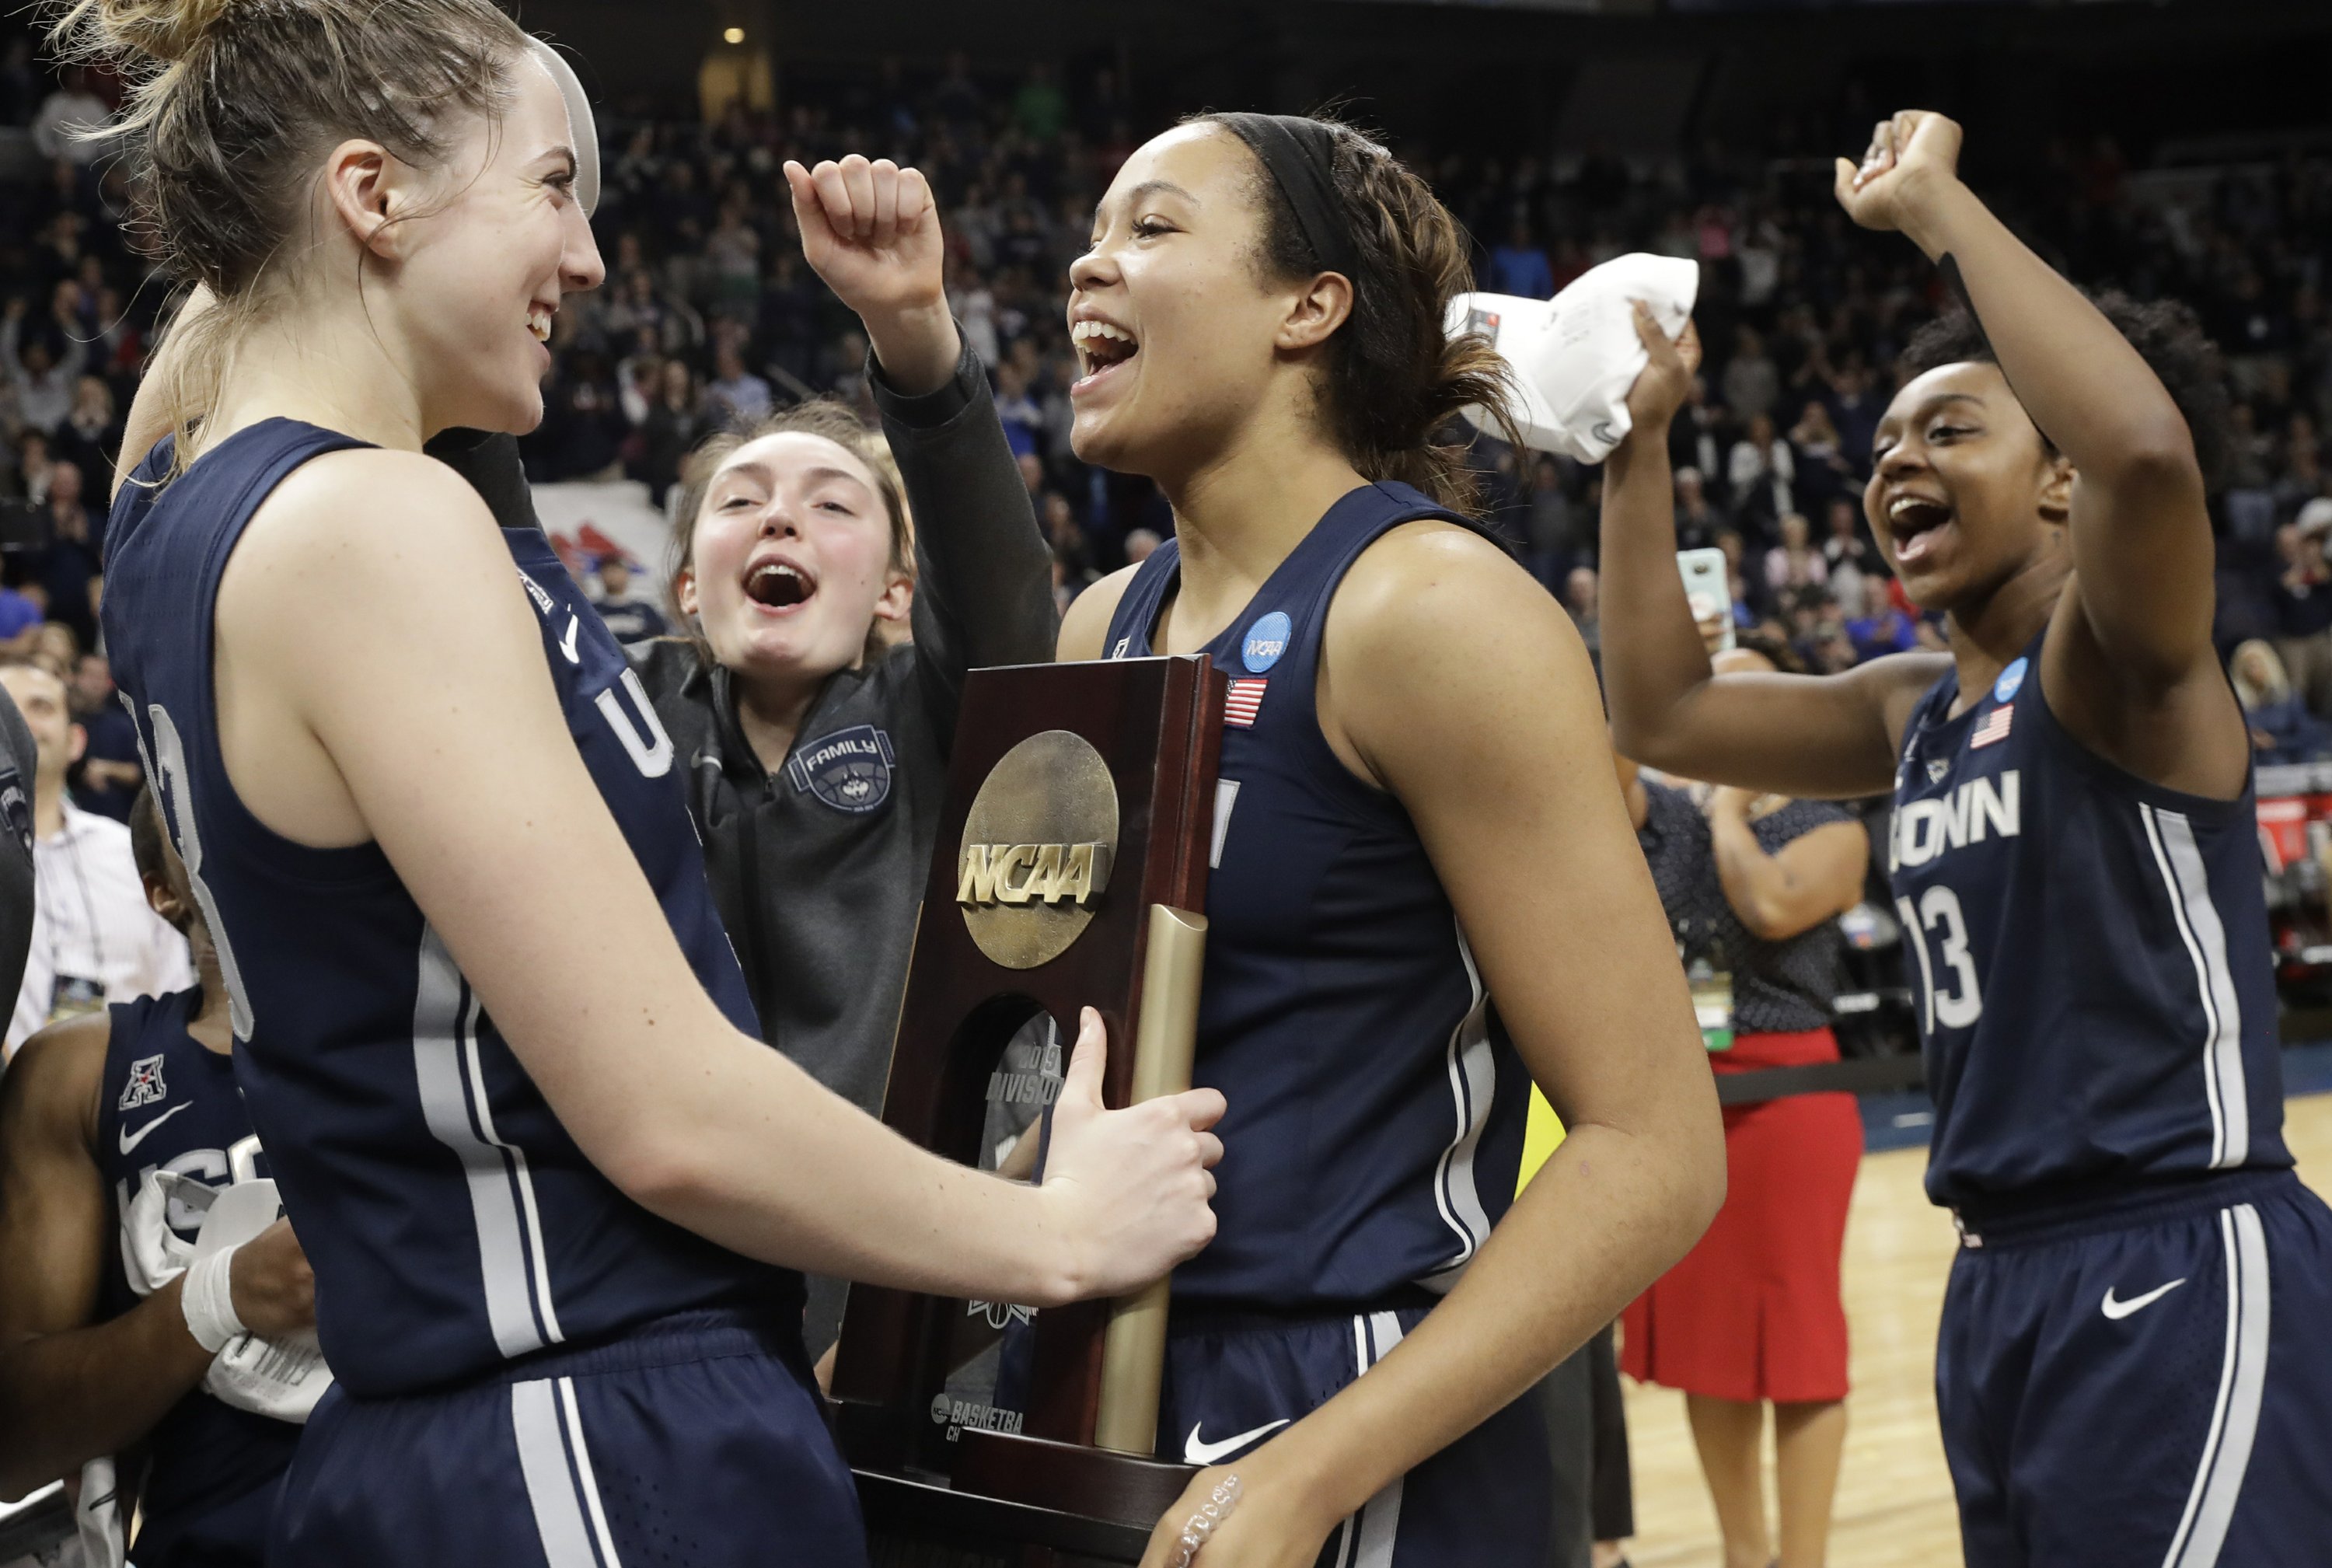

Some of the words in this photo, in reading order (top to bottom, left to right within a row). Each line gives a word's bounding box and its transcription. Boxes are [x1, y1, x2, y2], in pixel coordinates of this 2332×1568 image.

[805, 739, 878, 772] FAMILY
[955, 843, 1101, 905] NCAA
[1895, 885, 1982, 1035] 13
